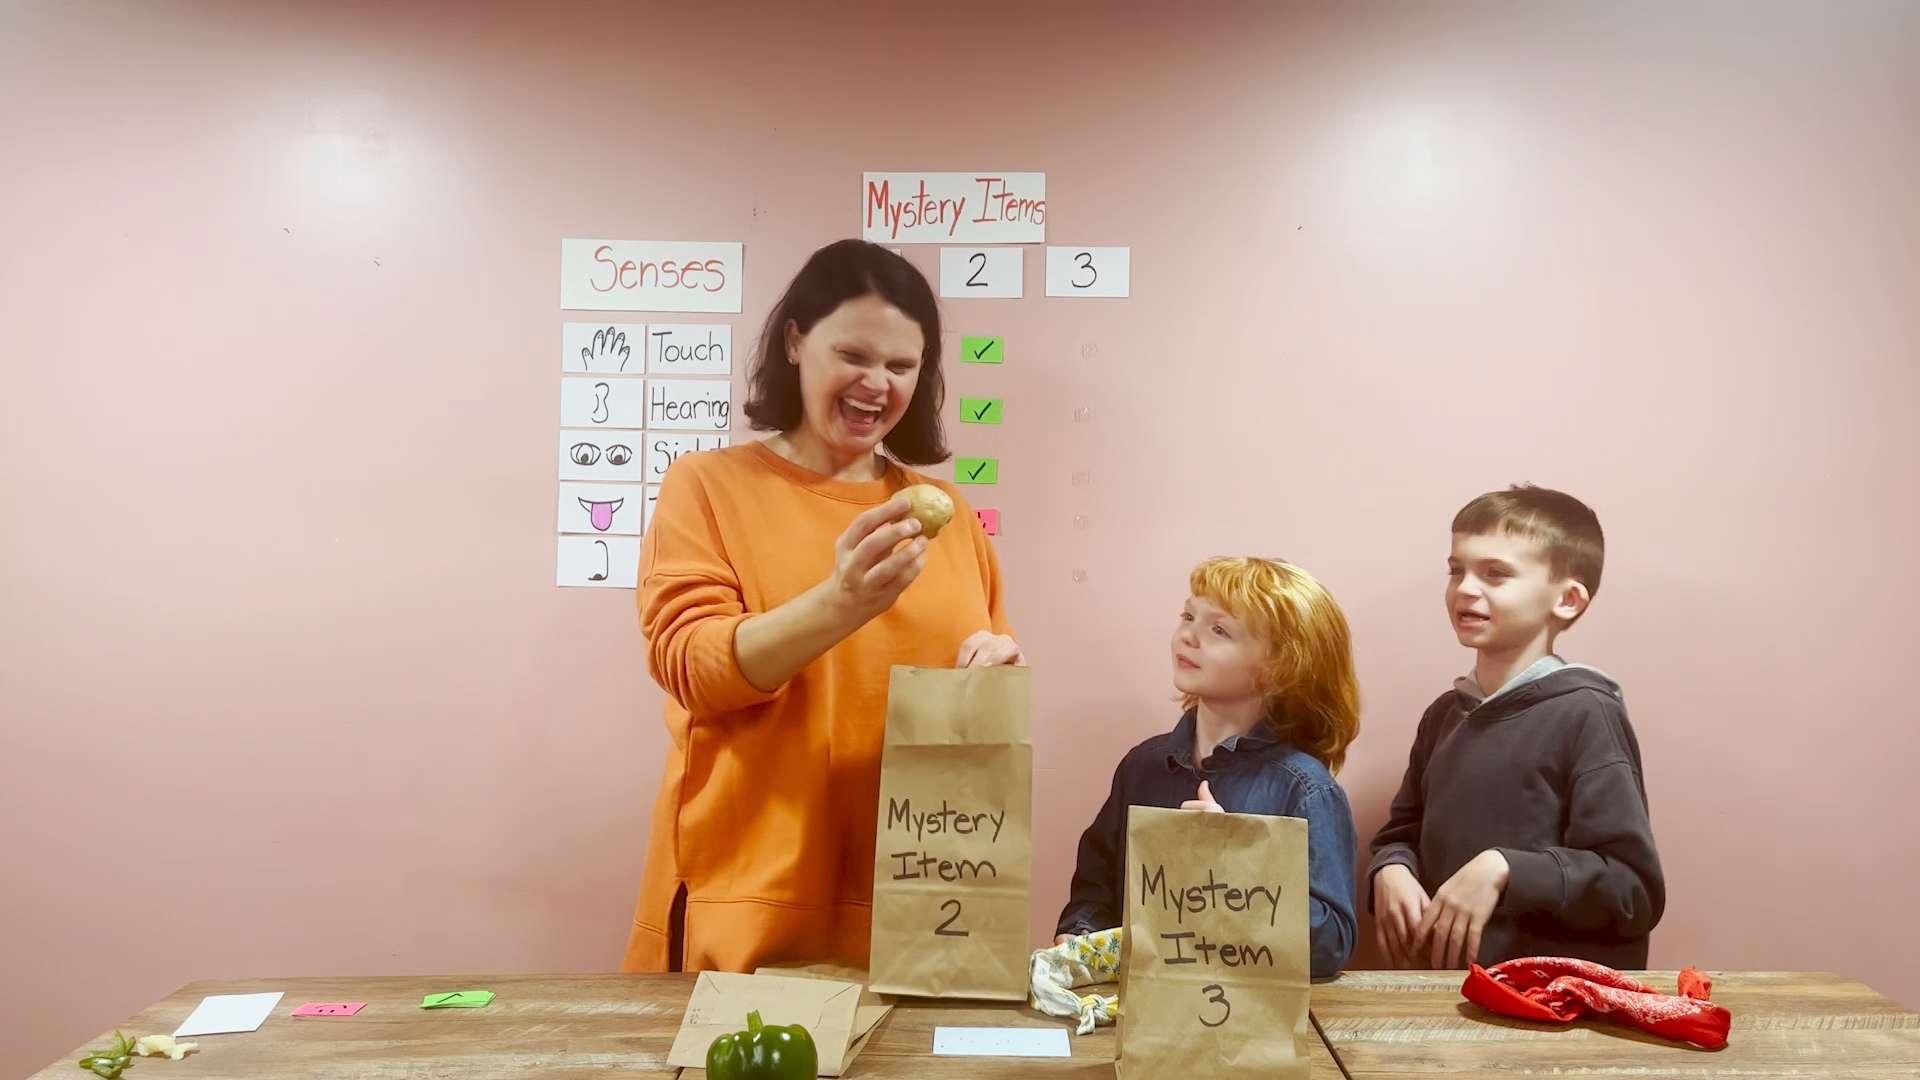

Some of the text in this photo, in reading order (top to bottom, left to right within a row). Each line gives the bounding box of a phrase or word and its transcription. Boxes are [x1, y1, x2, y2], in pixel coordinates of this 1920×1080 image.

[867, 177, 1046, 240] Mystery Items
[590, 245, 726, 292] Senses
[965, 252, 989, 287] 2
[1071, 252, 1098, 288] 3
[651, 330, 724, 363] Touch
[650, 386, 730, 429] Hearing
[887, 797, 1005, 843] Mystery
[891, 851, 997, 881] Item
[1141, 863, 1282, 927] Mystery
[934, 899, 970, 937] 2
[1160, 931, 1274, 968] Item
[1198, 983, 1231, 1028] 3
